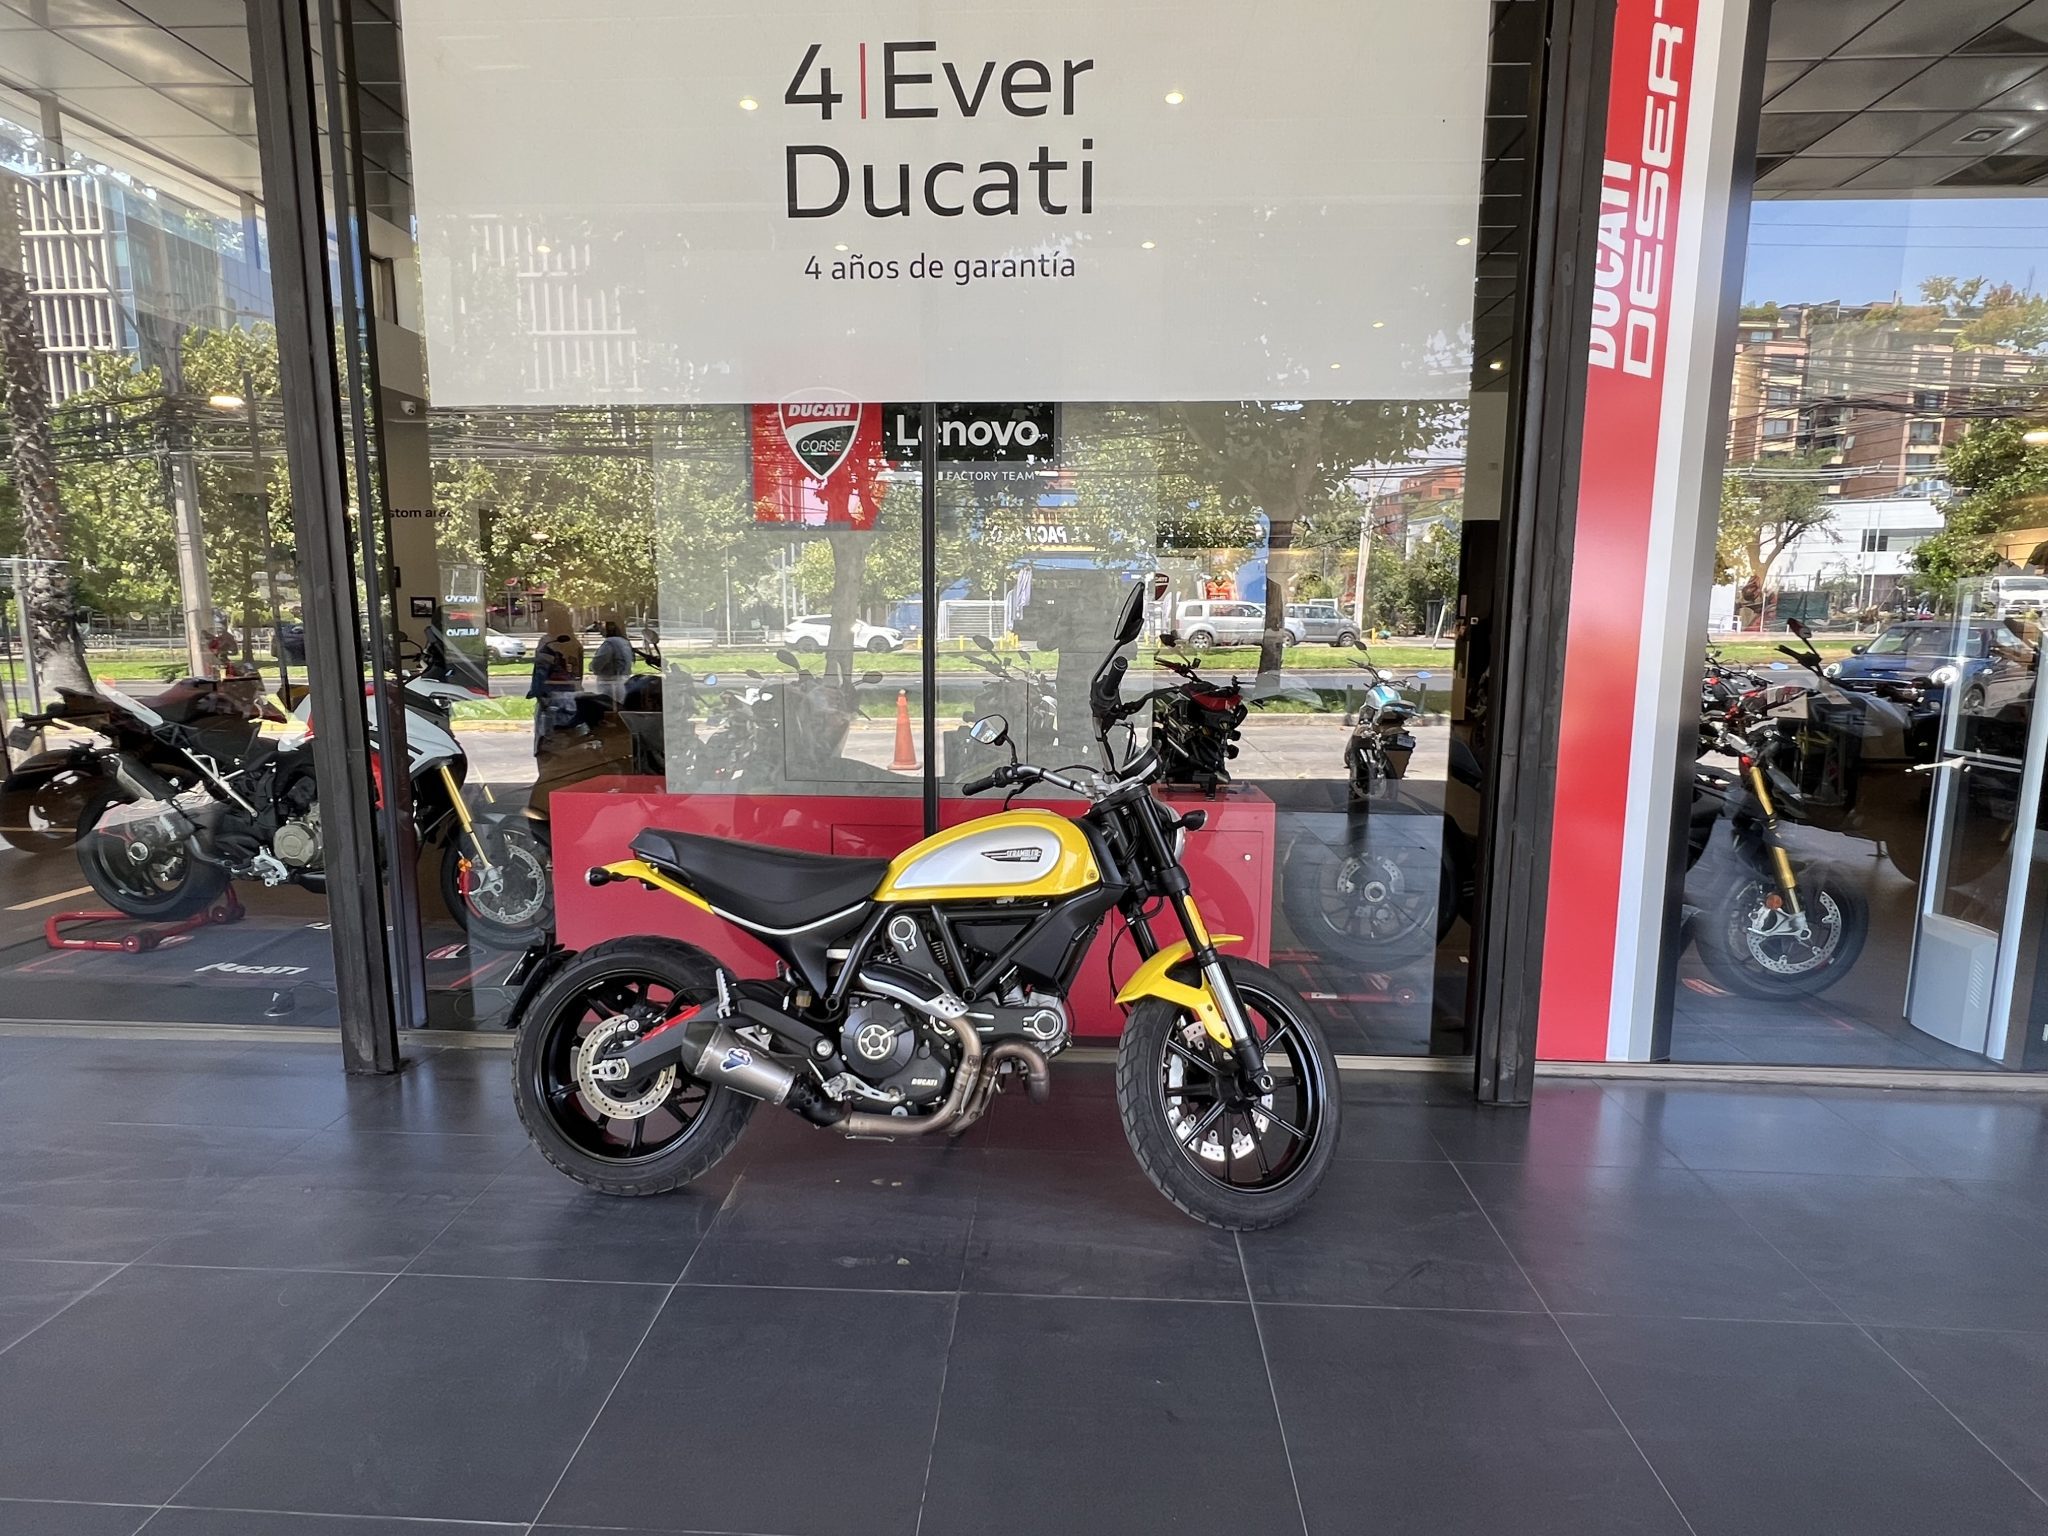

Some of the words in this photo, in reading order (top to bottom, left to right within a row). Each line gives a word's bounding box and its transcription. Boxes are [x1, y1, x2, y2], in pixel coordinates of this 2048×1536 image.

[786, 138, 1094, 218] Ducati
[1622, 0, 1684, 379] DESER
[804, 255, 822, 280] 4
[831, 254, 899, 280] años
[909, 252, 944, 279] de
[953, 251, 1076, 286] garantía
[788, 403, 851, 417] DUCATI
[800, 440, 842, 453] CORSE
[946, 471, 998, 481] FACTORY
[1002, 471, 1035, 481] TEAM
[911, 1078, 938, 1087] DUCATI
